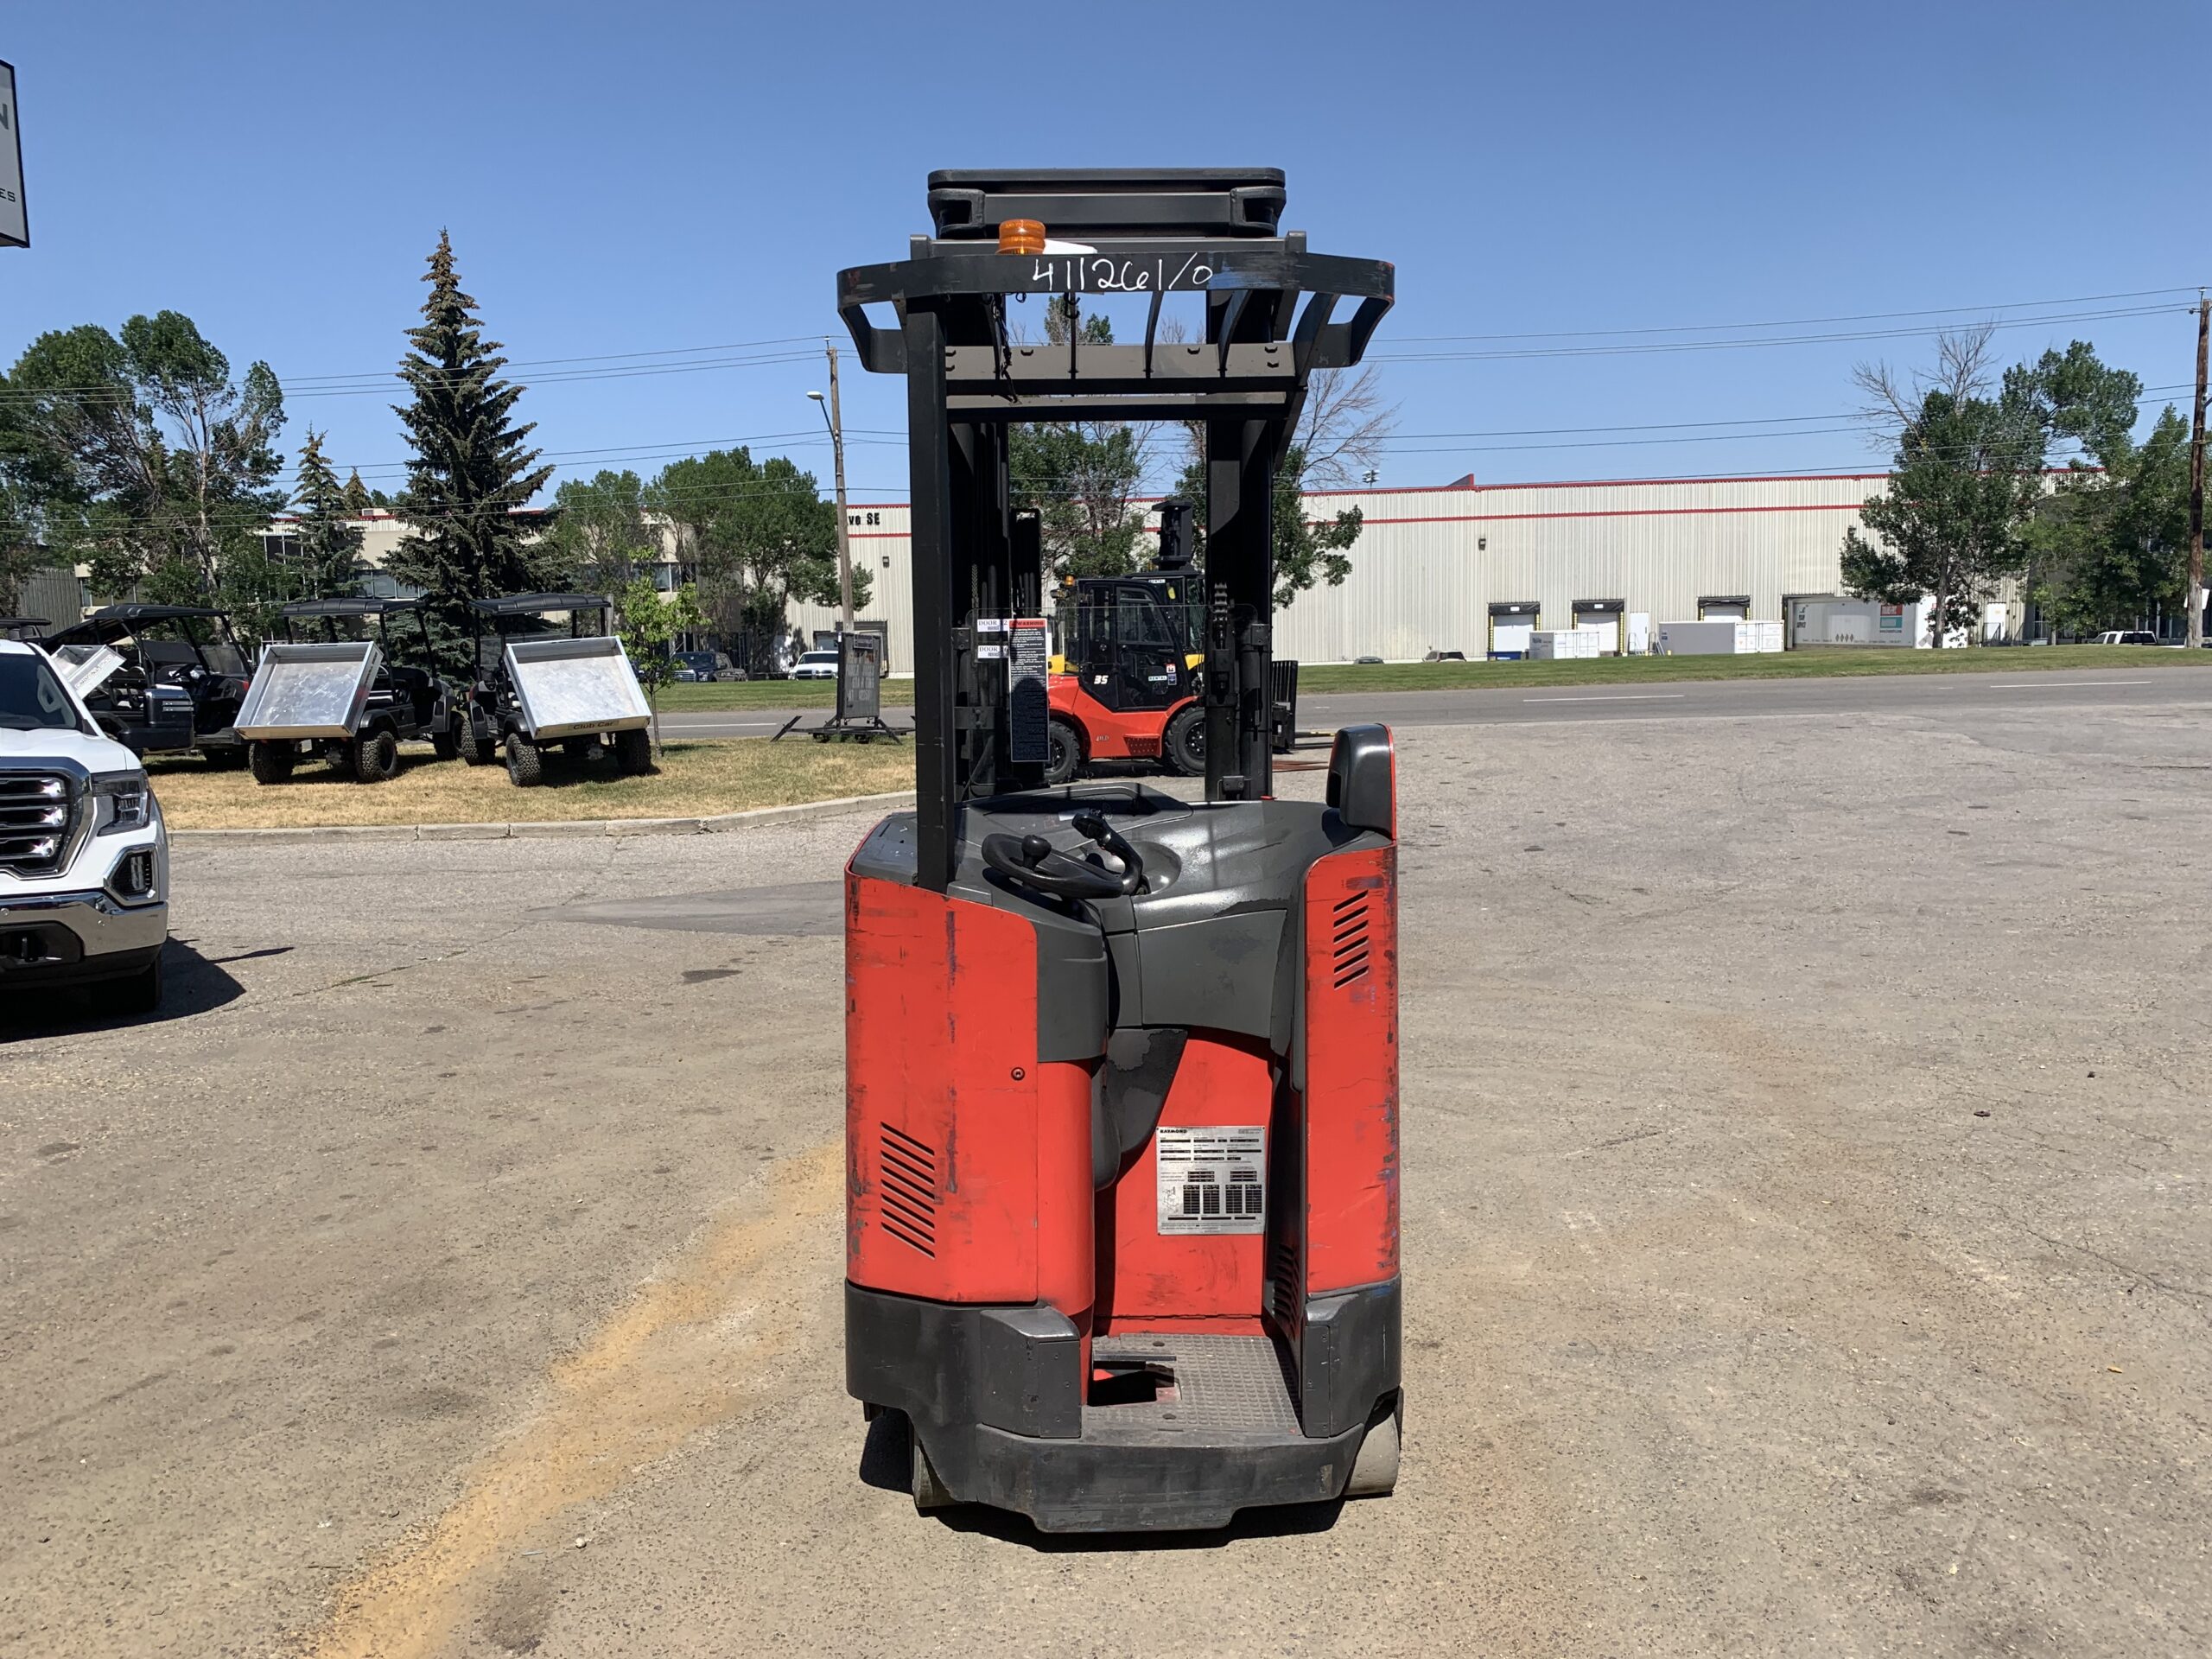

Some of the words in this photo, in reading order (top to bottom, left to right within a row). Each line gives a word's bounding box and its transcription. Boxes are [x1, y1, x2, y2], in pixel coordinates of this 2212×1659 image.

[848, 515, 861, 525] ve
[867, 512, 880, 525] SE
[1094, 675, 1109, 684] 35
